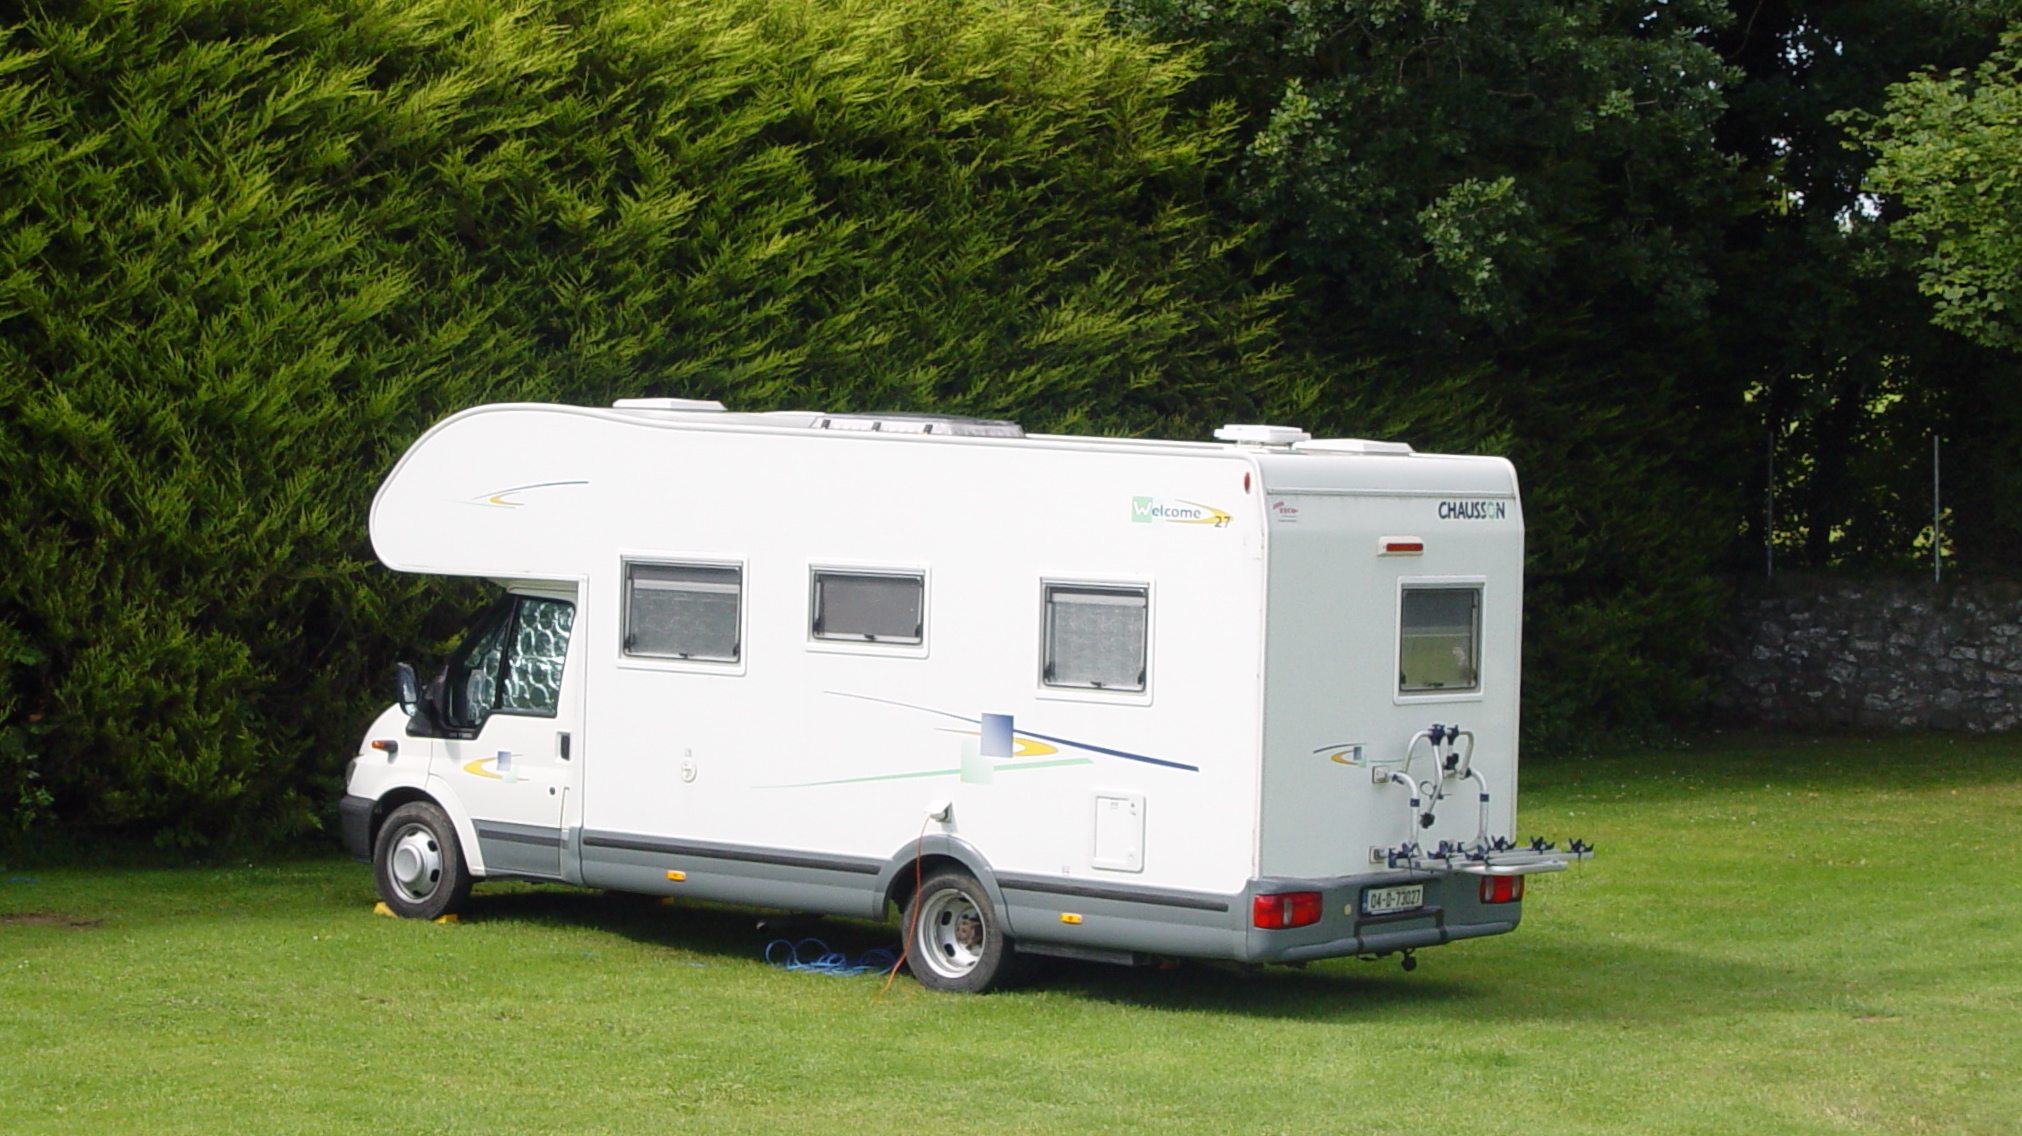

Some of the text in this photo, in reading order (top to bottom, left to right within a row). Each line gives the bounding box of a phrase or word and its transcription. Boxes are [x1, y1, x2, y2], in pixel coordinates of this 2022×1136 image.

[1133, 500, 1232, 529] Welcome 27
[1438, 500, 1506, 520] CHAUSSON
[1370, 889, 1421, 909] 04-D-73027
